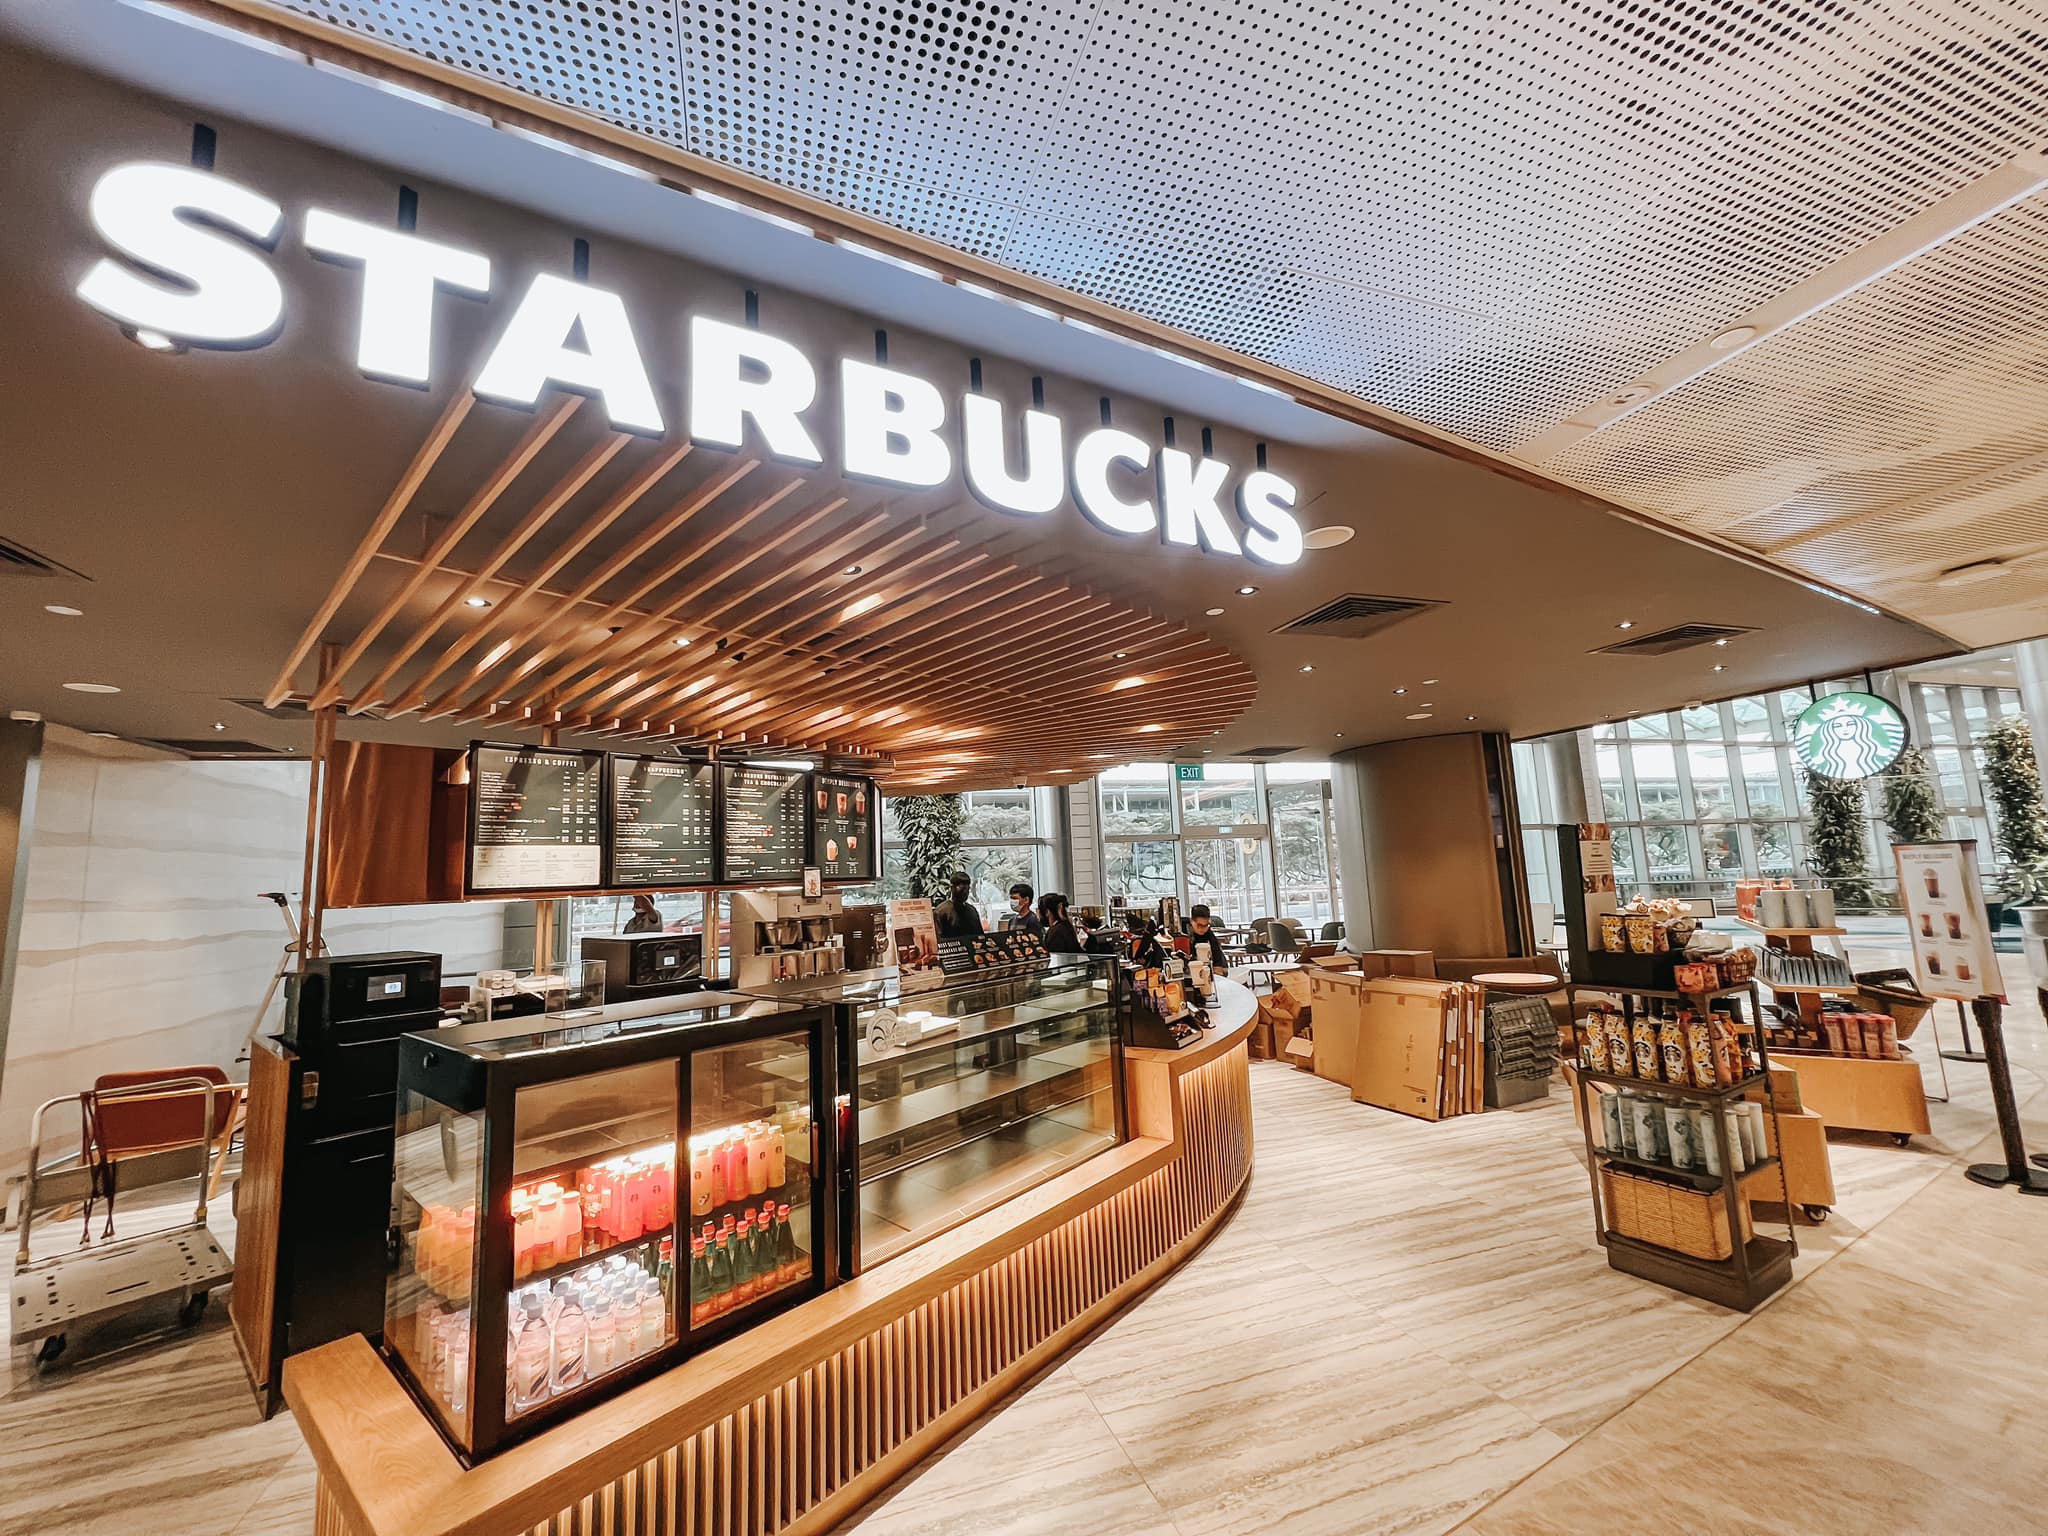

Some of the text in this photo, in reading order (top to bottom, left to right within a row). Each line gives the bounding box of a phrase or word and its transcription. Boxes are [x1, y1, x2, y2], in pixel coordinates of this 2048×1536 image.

[76, 163, 1305, 566] STARBUCKS
[552, 759, 578, 767] COFFEE
[1181, 767, 1200, 778] EXIT
